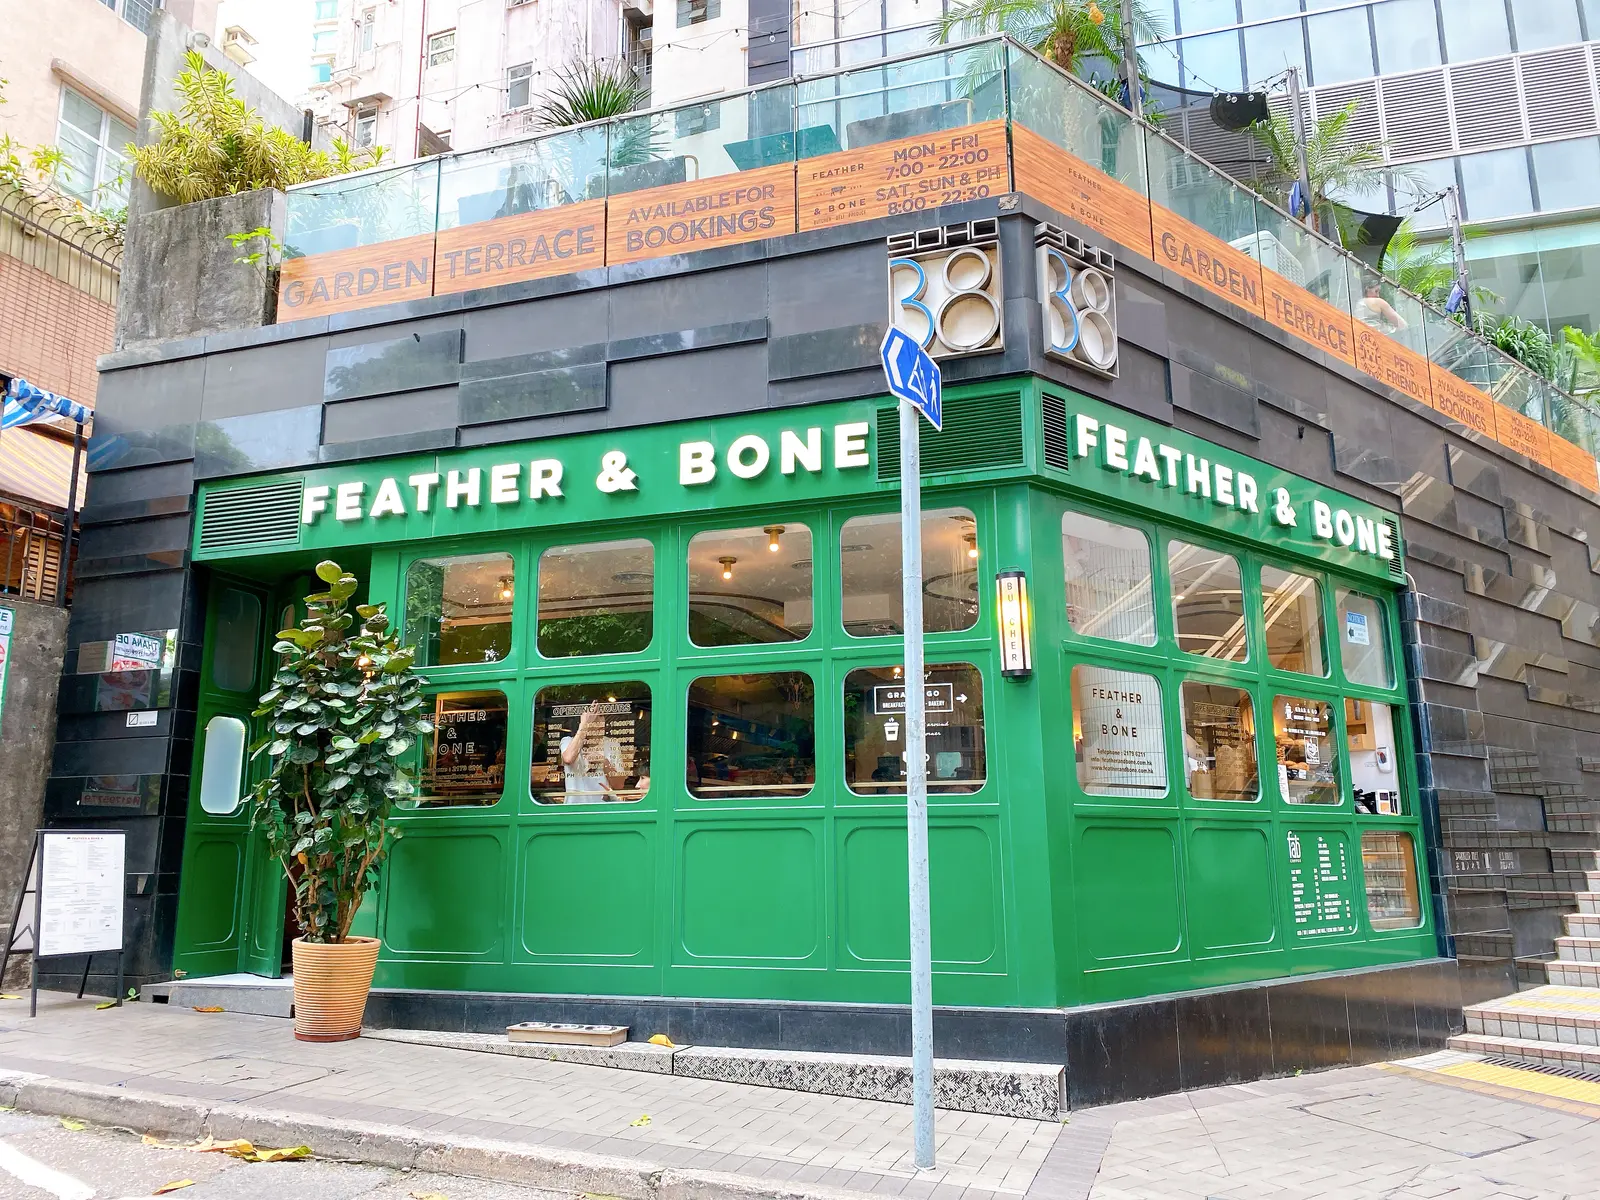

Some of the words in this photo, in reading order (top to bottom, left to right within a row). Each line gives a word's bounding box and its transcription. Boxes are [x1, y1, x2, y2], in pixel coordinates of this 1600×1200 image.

[893, 143, 936, 163] MON
[951, 134, 979, 152] FRI
[812, 163, 864, 180] FEATHER
[885, 160, 924, 181] 7:00
[938, 149, 989, 170] 22:00
[875, 182, 914, 202] SAT,
[918, 174, 955, 194] SUN
[959, 171, 972, 185] &
[976, 164, 1001, 184] PH
[626, 193, 730, 226] AVAILABLE
[733, 184, 776, 206] FOR
[814, 207, 821, 215] &
[828, 198, 866, 212] BONE
[887, 196, 926, 216] 8:00
[941, 184, 990, 206] 22:30
[1080, 207, 1104, 225] BONE
[626, 205, 776, 253] BOOKINGS
[887, 217, 1000, 251] SOHO
[283, 257, 429, 308] GARDEN
[444, 225, 596, 279] TERRACE
[890, 246, 1000, 352] 38
[1160, 232, 1257, 306] GARDEN
[1271, 291, 1349, 356] TERRACE
[1393, 355, 1415, 378] PETS
[1386, 368, 1427, 401] FRIENDLY
[1437, 379, 1472, 406] AVAILABLE
[1439, 394, 1487, 432] BOOKINGS
[302, 458, 565, 525] FEATHER
[595, 450, 640, 494] &
[678, 422, 870, 487] BONE
[1072, 413, 1259, 515] FEATHER
[1270, 487, 1298, 528] &
[1312, 499, 1395, 561] BONE
[1006, 582, 1018, 661] BUCHER
[552, 705, 596, 717] OPENING
[599, 703, 632, 714] HOURS
[887, 691, 906, 699] GRA
[1092, 688, 1142, 704] FEATHER
[1115, 708, 1123, 719] &
[446, 727, 457, 739] &
[1101, 724, 1138, 738] BONE
[438, 742, 475, 756] ONE
